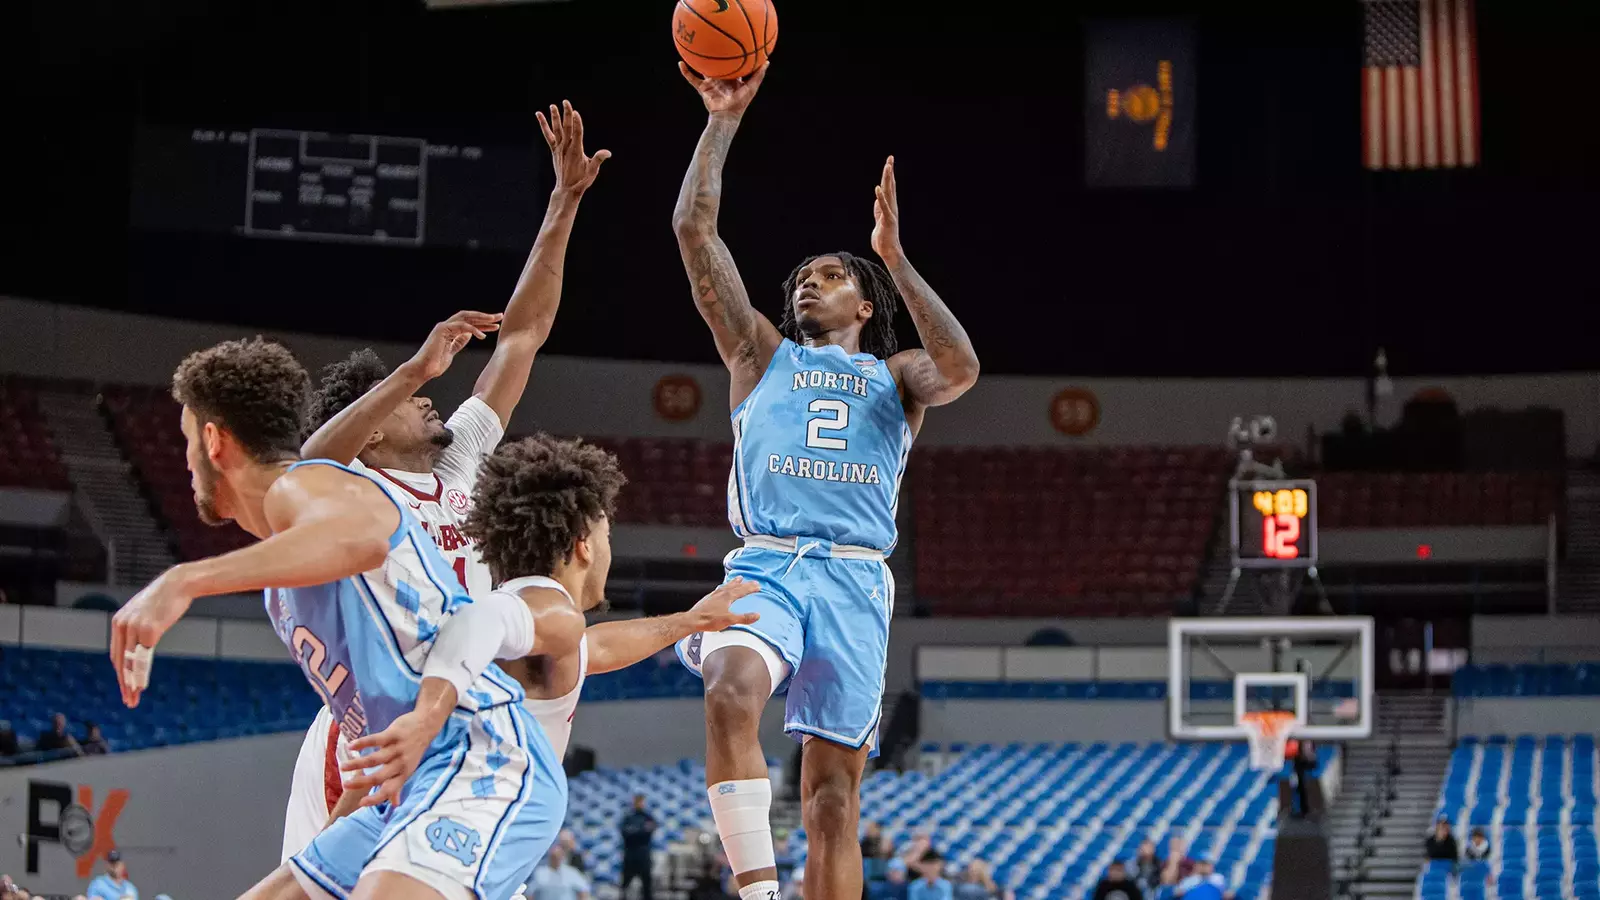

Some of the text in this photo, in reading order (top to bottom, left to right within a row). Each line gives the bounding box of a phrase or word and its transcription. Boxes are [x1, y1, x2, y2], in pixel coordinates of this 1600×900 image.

[792, 369, 868, 398] NORTH
[806, 398, 850, 451] 2
[768, 453, 881, 485] CAROLINA
[1263, 513, 1300, 559] 12
[291, 625, 350, 700] 2
